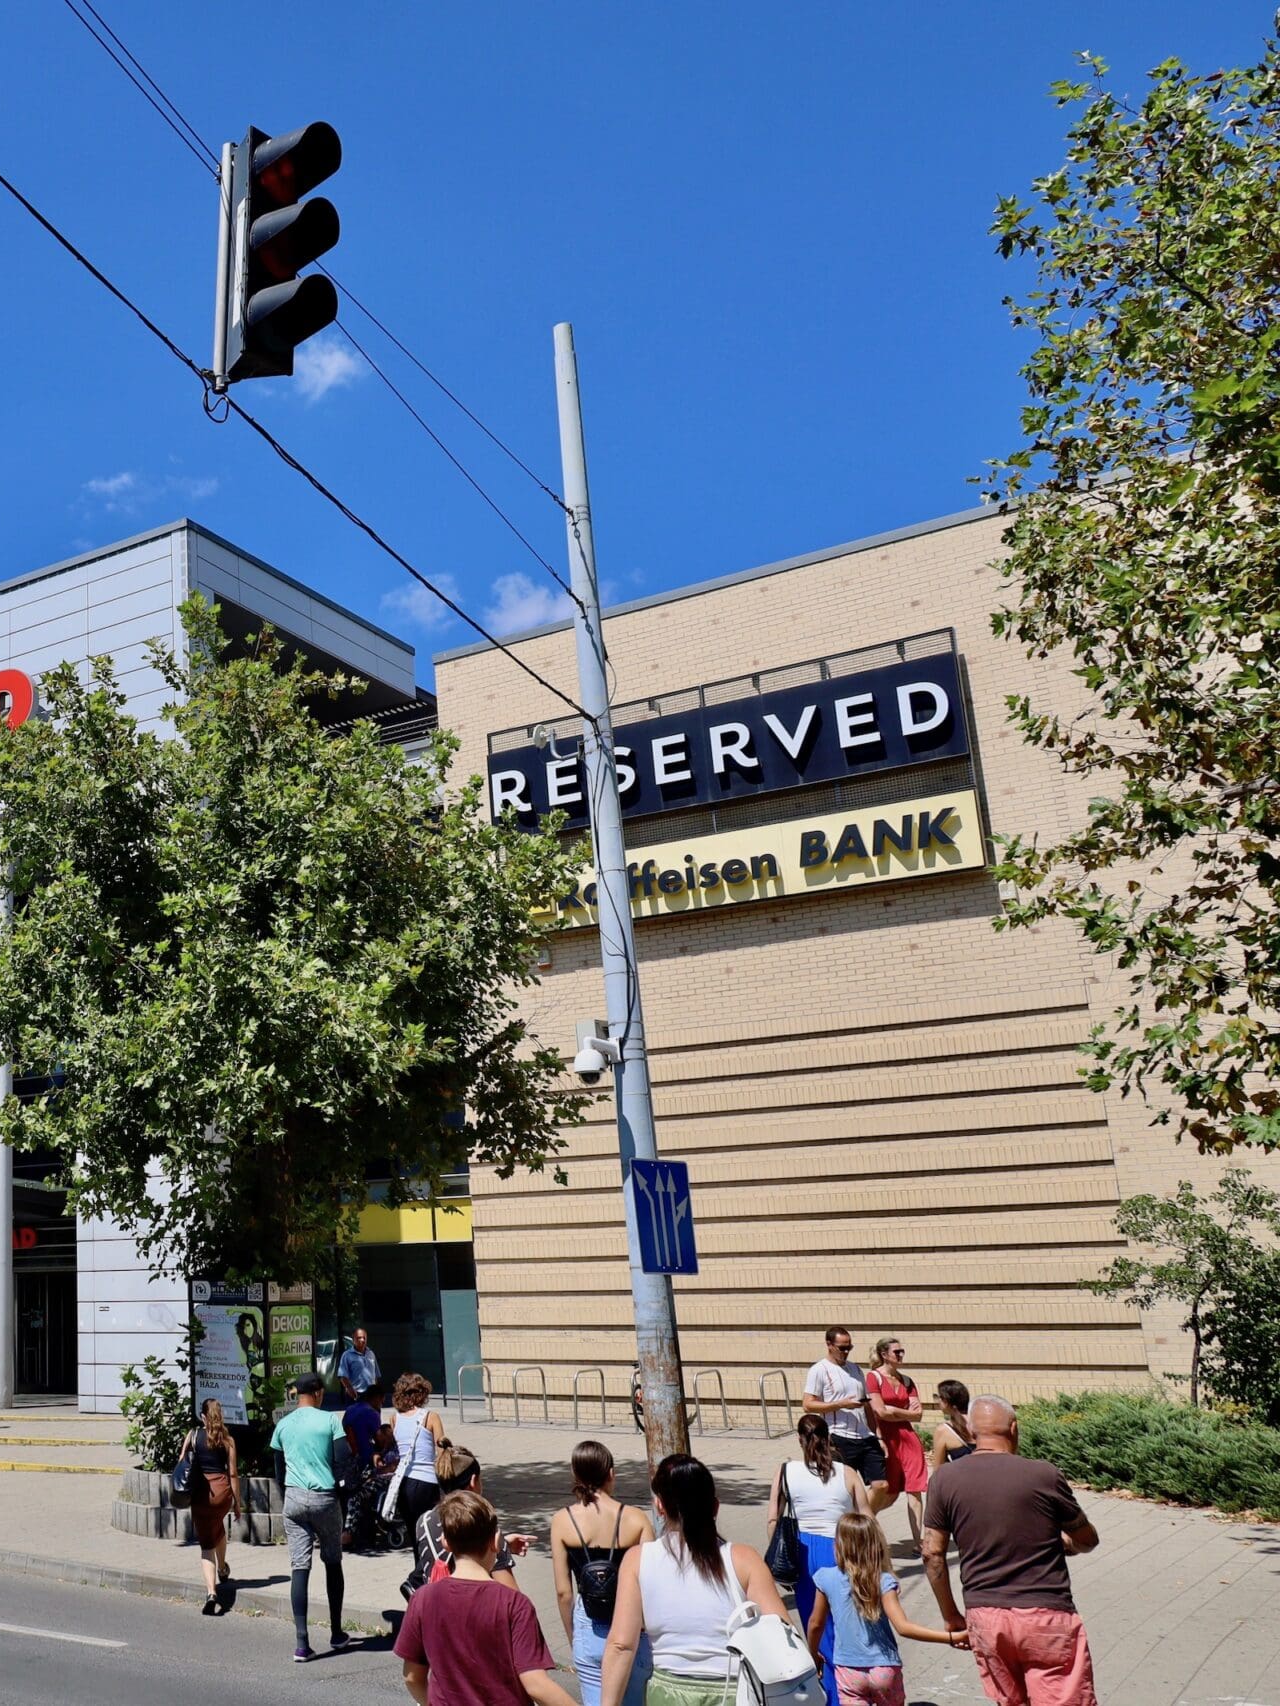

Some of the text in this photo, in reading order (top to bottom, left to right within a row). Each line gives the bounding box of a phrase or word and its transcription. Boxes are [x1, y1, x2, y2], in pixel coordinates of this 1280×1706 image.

[490, 680, 950, 818] RESERVED
[558, 806, 957, 910] Rffeisen BANK
[271, 1340, 311, 1355] GRAFIKA
[272, 1314, 310, 1332] DEKOR
